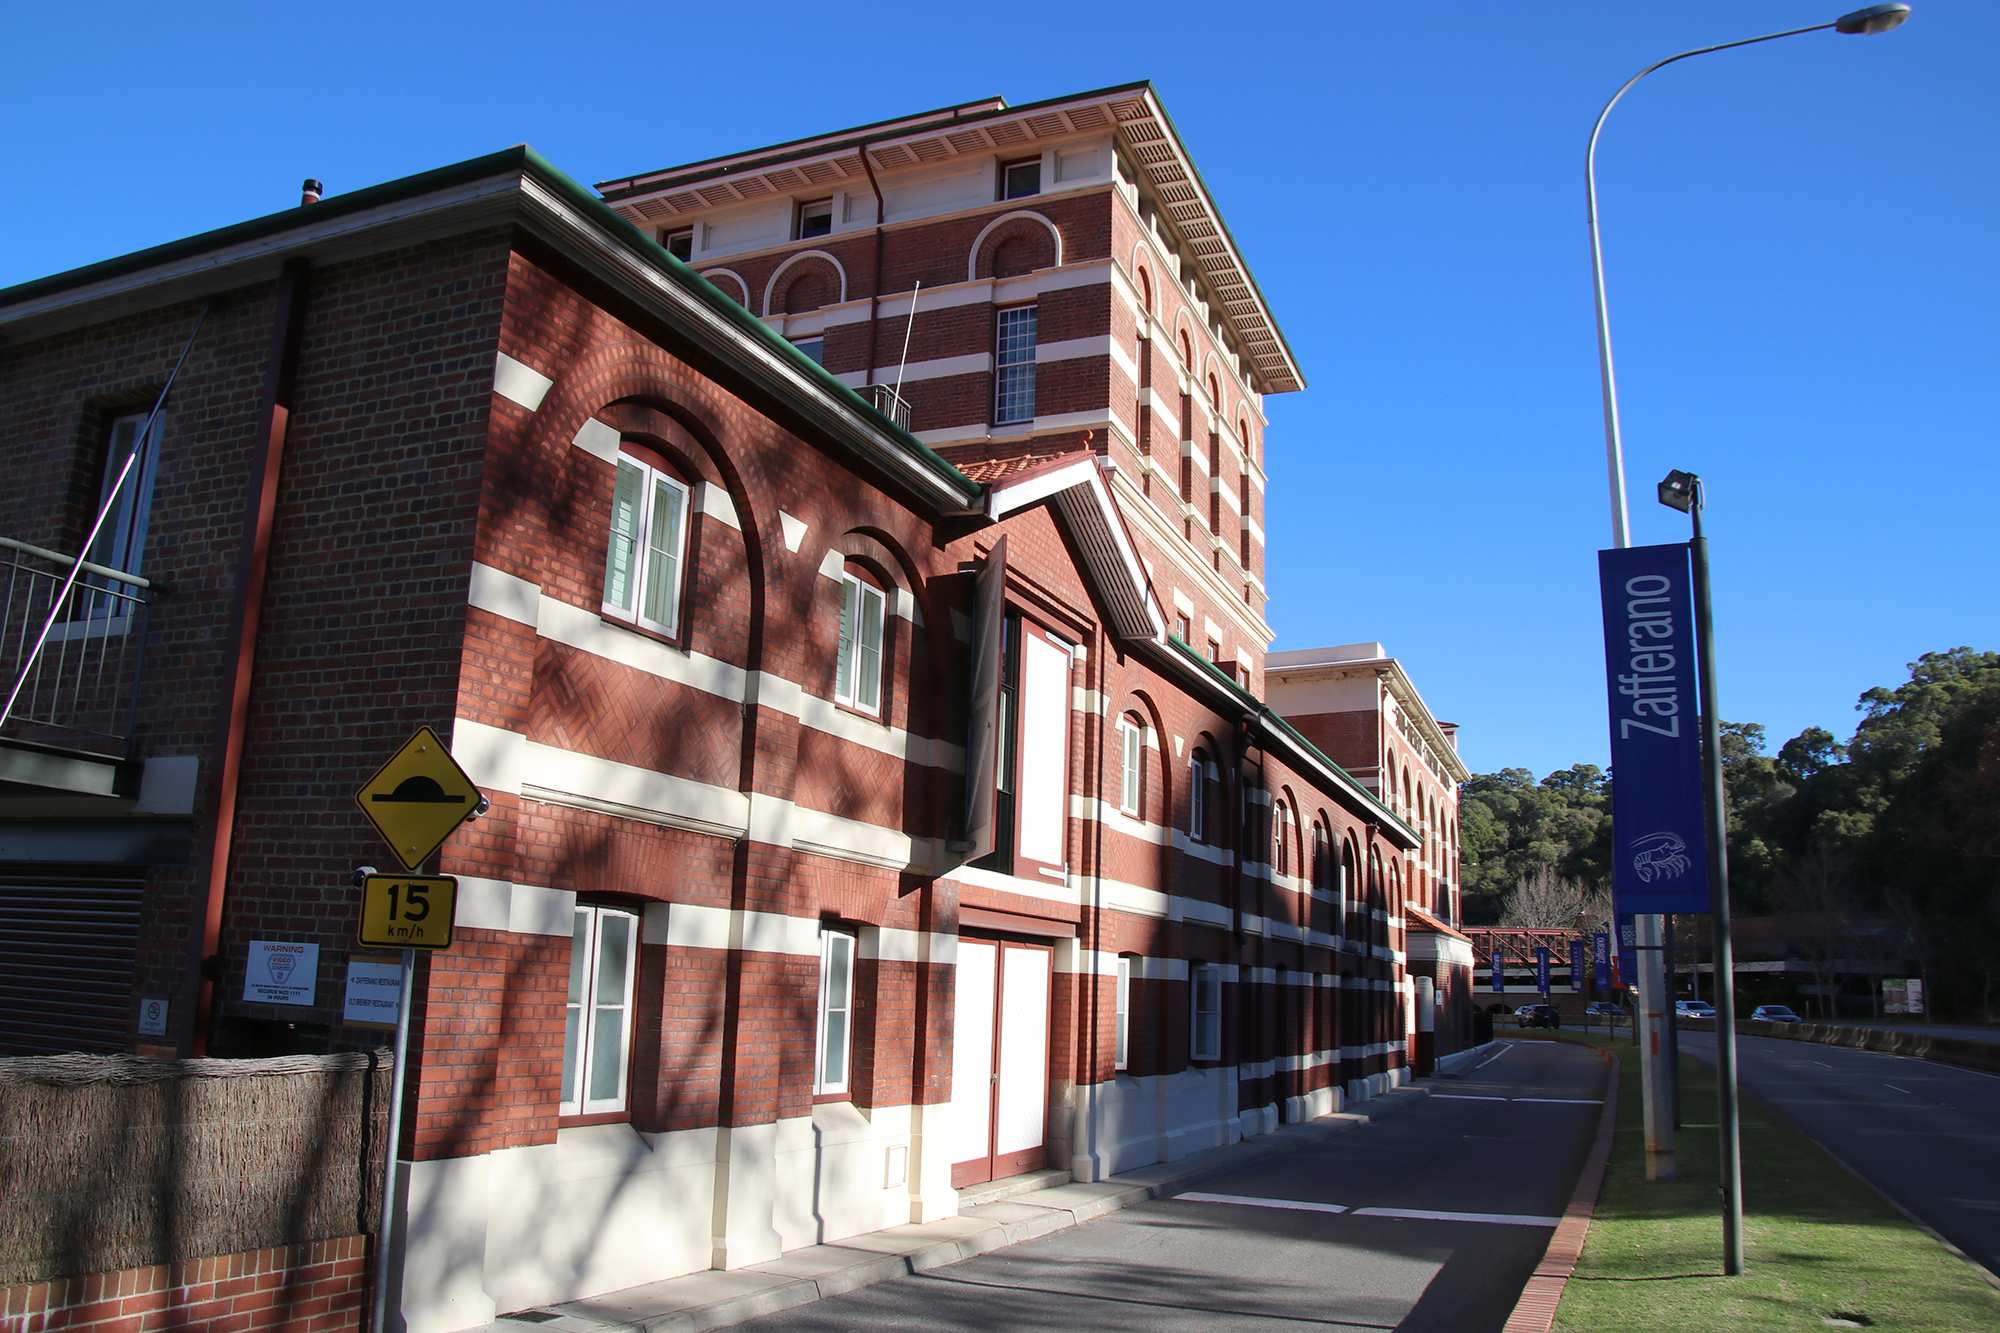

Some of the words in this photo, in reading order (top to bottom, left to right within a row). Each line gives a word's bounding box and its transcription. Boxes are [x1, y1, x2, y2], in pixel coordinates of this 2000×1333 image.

[1617, 574, 1681, 740] Zafferano
[387, 884, 430, 922] 15
[387, 924, 424, 939] km/h
[263, 944, 305, 954] WARNING
